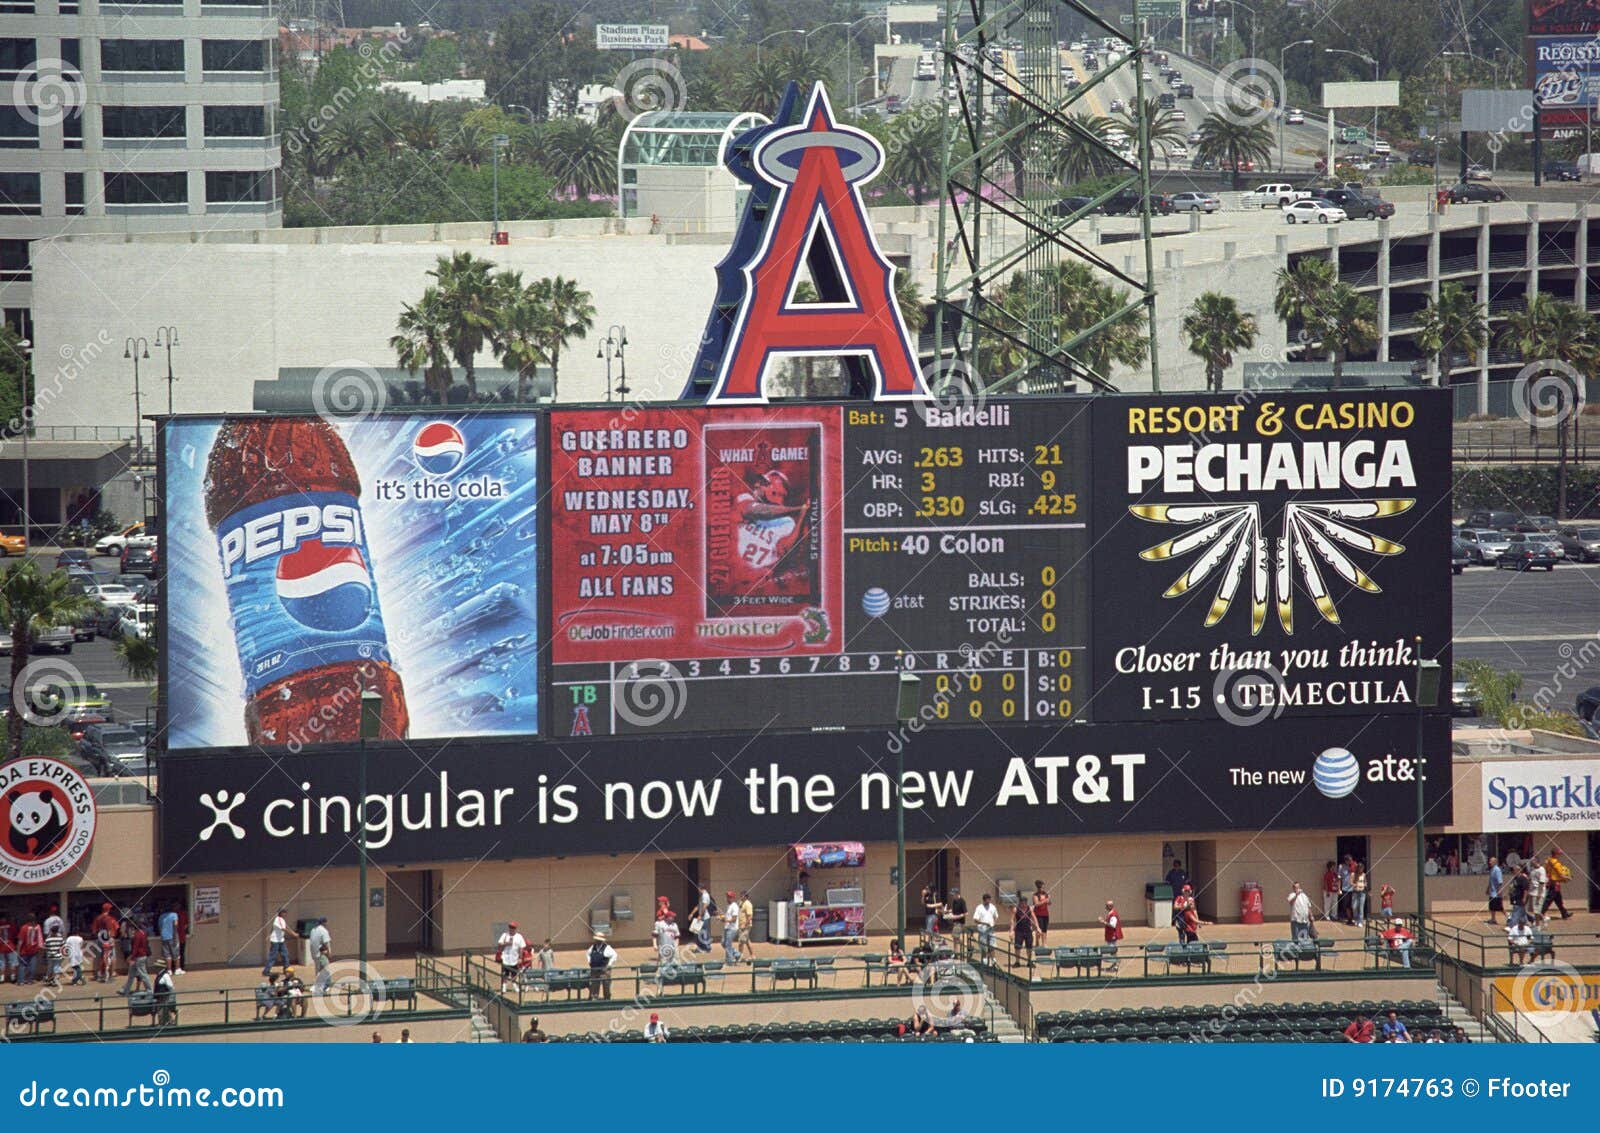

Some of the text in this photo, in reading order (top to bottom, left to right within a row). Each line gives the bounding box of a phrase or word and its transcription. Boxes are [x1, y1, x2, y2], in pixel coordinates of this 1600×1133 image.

[600, 25, 666, 35] Stadium Plaza
[601, 34, 666, 44] Business Park
[712, 80, 936, 404] A
[849, 405, 1010, 428] Bat: 5 Baldelli
[1129, 401, 1415, 436] RESORT & CASINO
[562, 429, 689, 452] GUERRERO
[719, 448, 754, 463] WHAT
[771, 447, 808, 462] GAME!
[862, 447, 964, 468] AVG: .263
[978, 444, 1064, 465] HITS: 21
[578, 456, 673, 477] BANNER
[1127, 439, 1417, 494] PECHANGA
[375, 479, 407, 501] it's
[413, 478, 450, 499] the
[872, 472, 936, 492] HR: 3
[989, 470, 1056, 490] RBI: 9
[564, 488, 694, 511] WEDNESDAY,
[863, 496, 965, 518] OBP: .330
[979, 494, 1077, 516] SLG: .425
[590, 514, 633, 534] MAY
[221, 505, 363, 578] PEPSI
[849, 533, 1005, 555] Pitch: 40 Colon
[580, 552, 596, 565] at
[743, 543, 770, 565] 27
[579, 576, 674, 598] ALL FANS
[968, 566, 1056, 588] BALLS: 0
[894, 594, 925, 609] at&t
[949, 589, 1056, 611] STRIKES: 0
[696, 621, 783, 638] monster
[967, 612, 1056, 633] TOTAL: 0
[630, 663, 641, 679] 1
[659, 662, 672, 678] 2
[688, 661, 700, 677] 3
[719, 659, 732, 676] 4
[749, 659, 761, 674] 5
[779, 657, 791, 673] 6
[808, 657, 820, 672] 7
[839, 655, 851, 672] 8
[868, 655, 880, 670] 9
[937, 653, 949, 669] R
[969, 652, 980, 668] H
[1003, 651, 1014, 666] E
[1058, 650, 1072, 668] 0
[1115, 646, 1201, 674] Closer
[1210, 643, 1272, 671] than
[1282, 648, 1329, 676] you
[936, 672, 1015, 693] 0 0 0
[1058, 674, 1072, 692] 0
[569, 685, 597, 704] TB
[1142, 681, 1411, 710] I-15 TEMECULA
[936, 699, 1015, 719] 0 0 0
[1058, 699, 1072, 718] 0
[1229, 767, 1263, 787] The
[1267, 770, 1306, 785] new
[29, 762, 91, 815] EXPRESS
[263, 753, 1146, 849] cingular is now the new AT&T
[23, 858, 69, 880] CHINESE
[68, 830, 89, 860] FOOD
